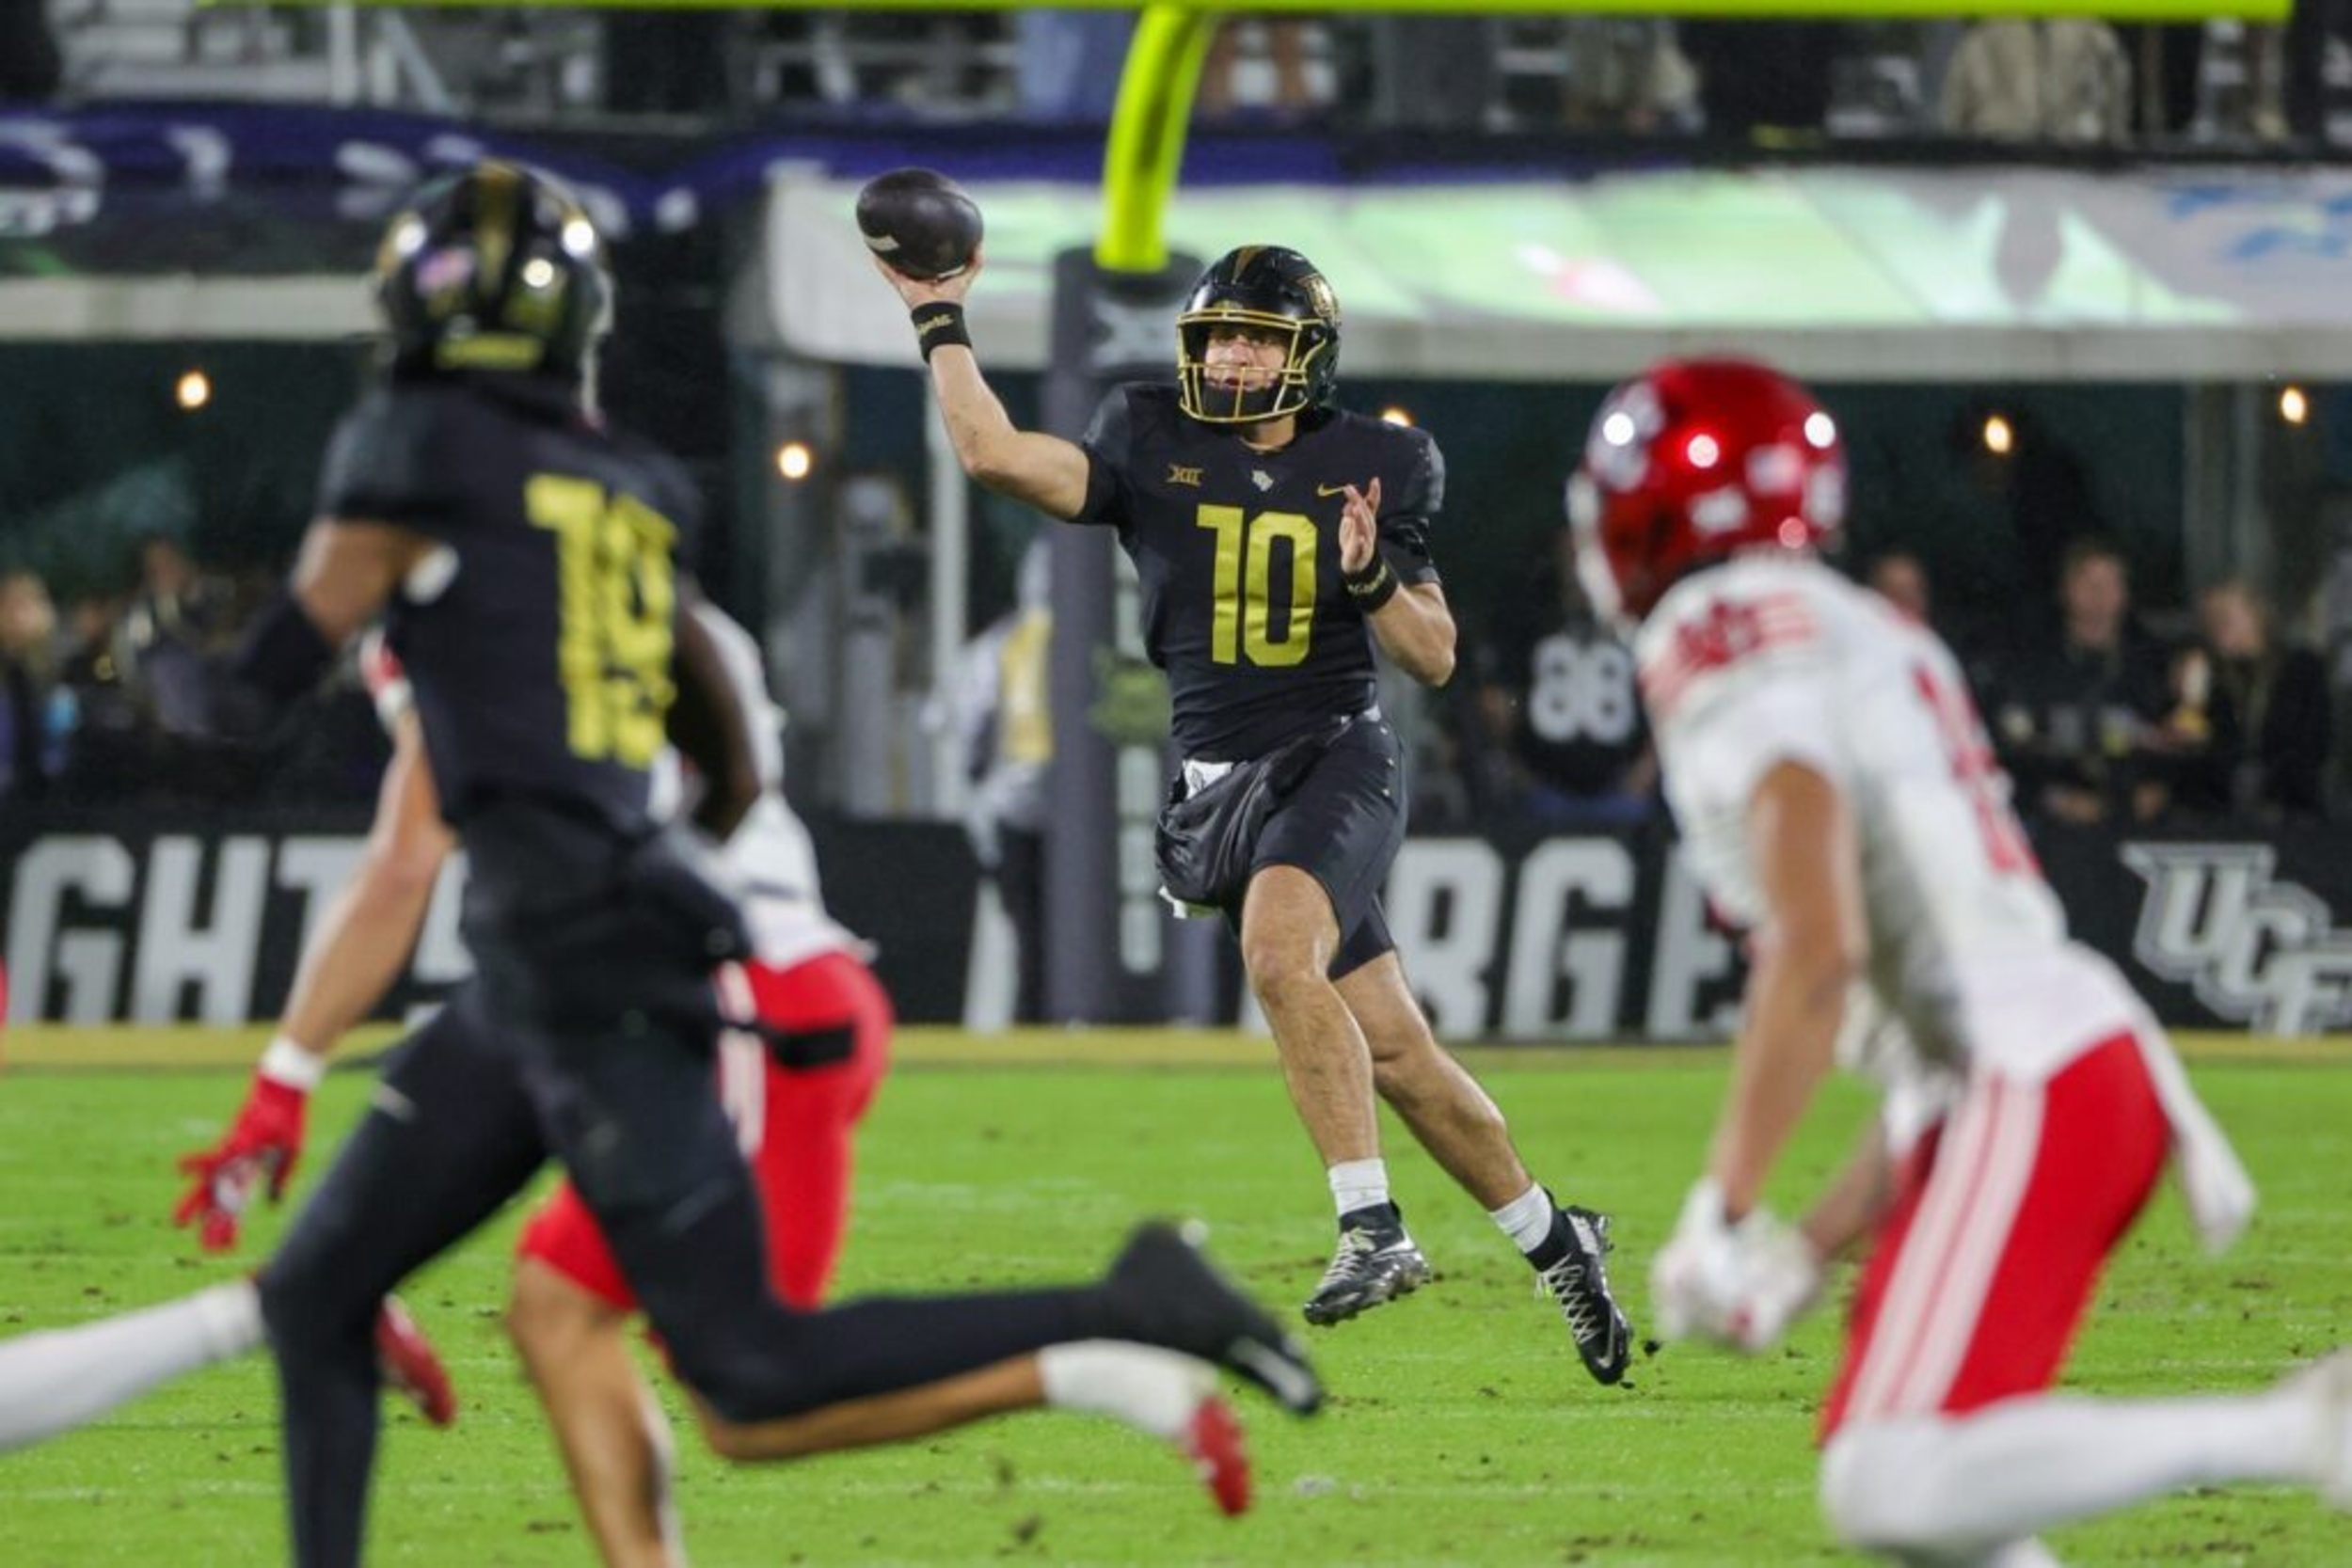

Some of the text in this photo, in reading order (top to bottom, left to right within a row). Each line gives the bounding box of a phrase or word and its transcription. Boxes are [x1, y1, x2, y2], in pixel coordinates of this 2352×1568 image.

[1196, 503, 1317, 666] 10
[1530, 633, 1637, 745] 88
[2120, 840, 2352, 1038] UCF
